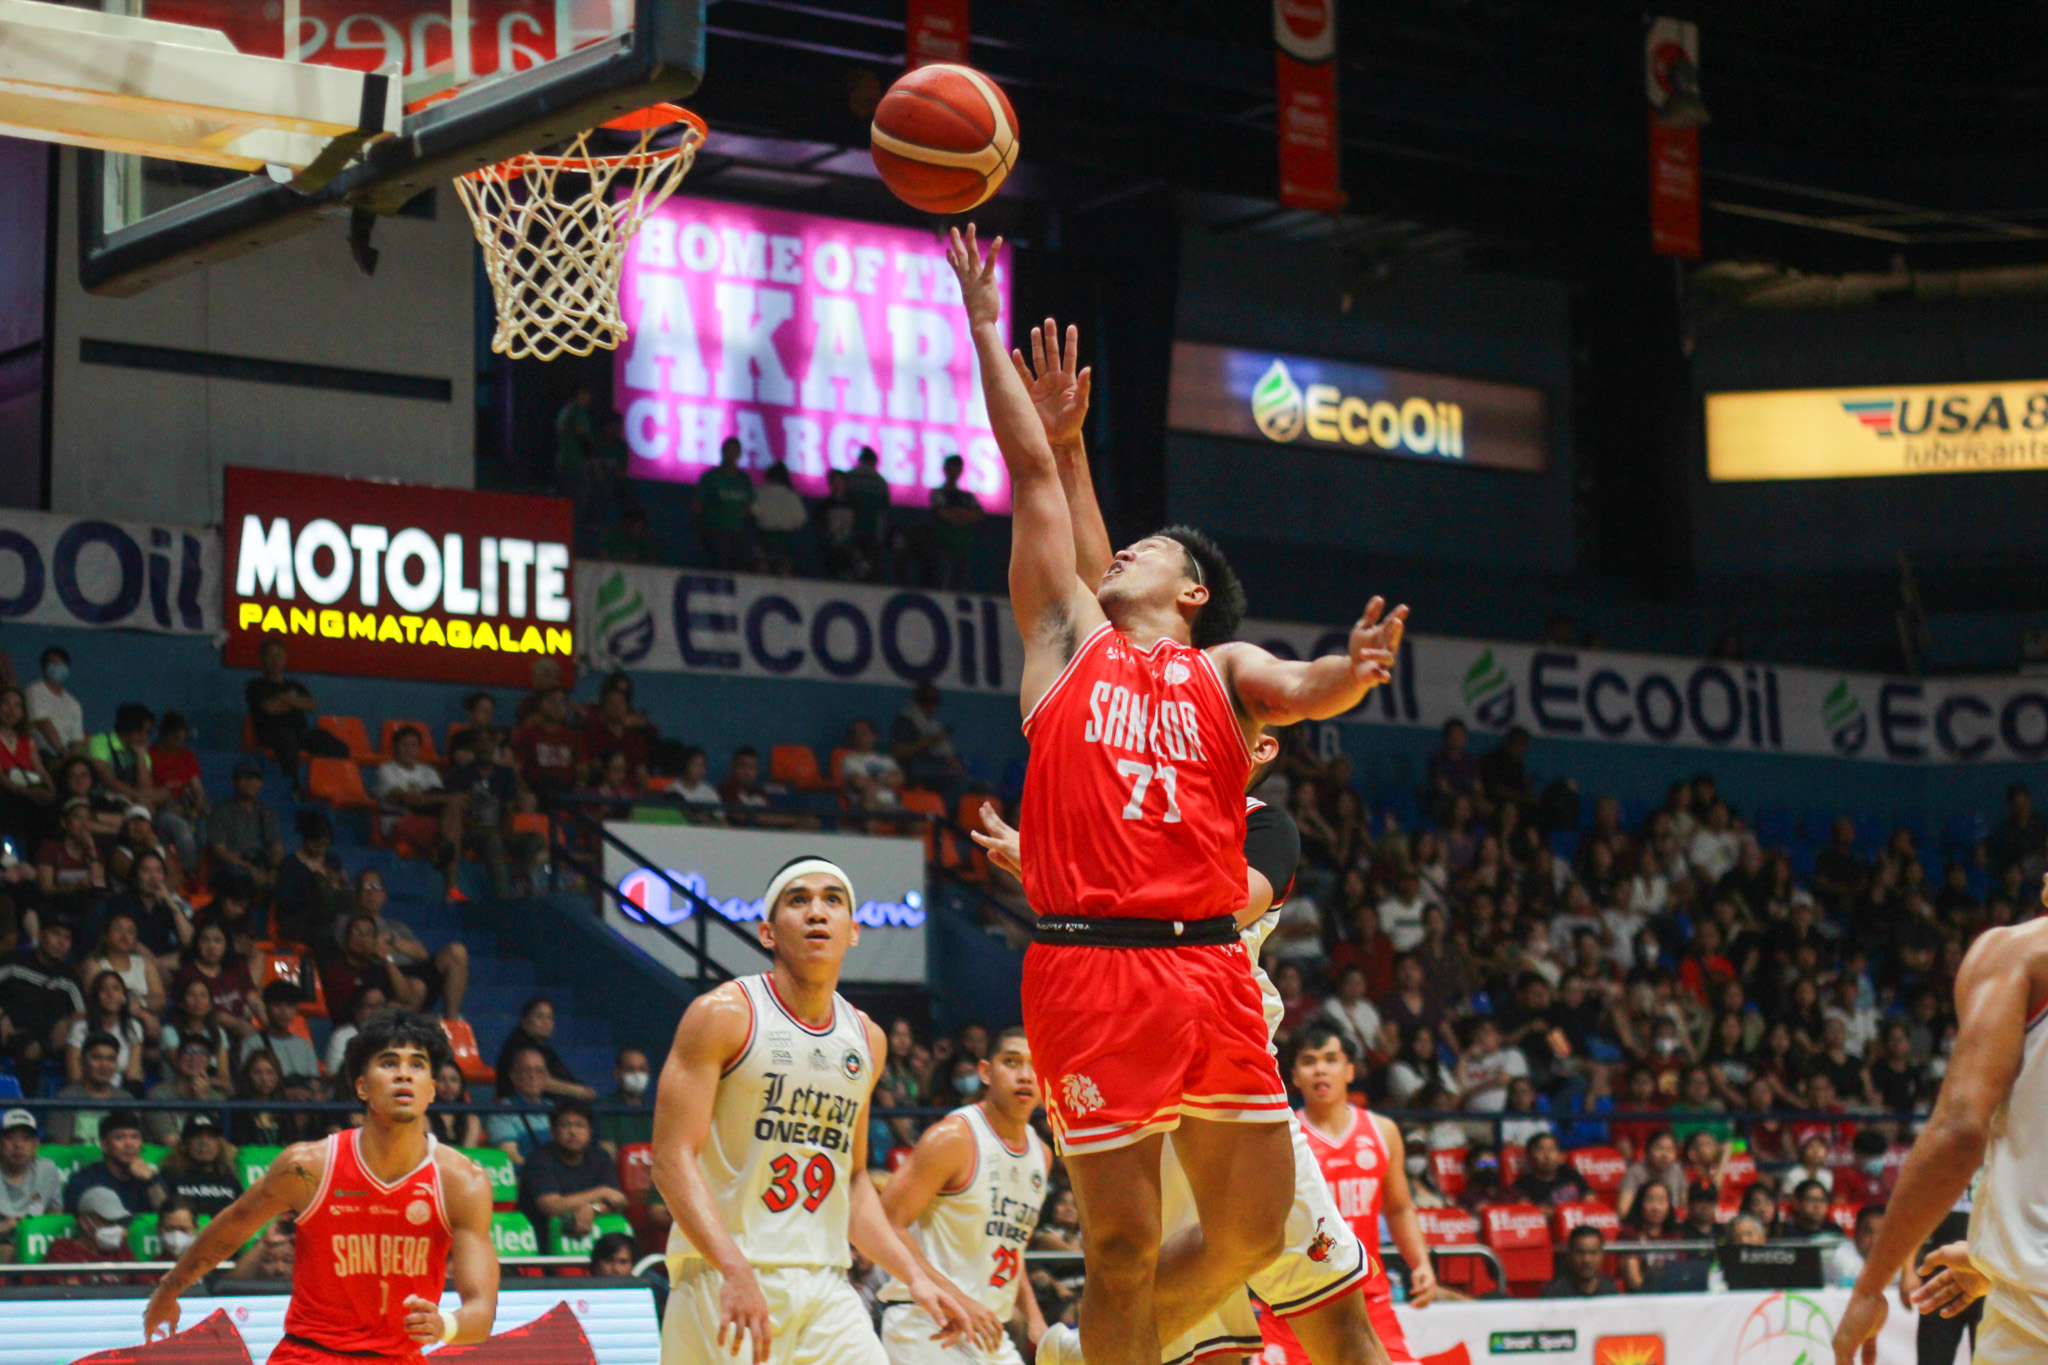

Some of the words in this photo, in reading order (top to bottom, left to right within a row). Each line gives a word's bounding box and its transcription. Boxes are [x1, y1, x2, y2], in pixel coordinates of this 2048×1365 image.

[639, 216, 803, 286] HOME
[811, 240, 887, 295] OF
[895, 250, 1004, 311] TH
[1305, 384, 1464, 459] EcoOil
[1898, 395, 2011, 436] USA
[236, 514, 572, 622] MOTOLITE
[238, 603, 573, 656] PANGMATAGALAN
[672, 574, 1003, 687] EcoOil
[1085, 680, 1150, 754] SAN
[1530, 651, 1784, 752] EcoOil
[1876, 682, 2048, 762] Eco
[760, 1071, 859, 1129] Letran
[761, 1152, 836, 1214] 39
[332, 1234, 378, 1277] SAN
[380, 1234, 431, 1277] BEDA
